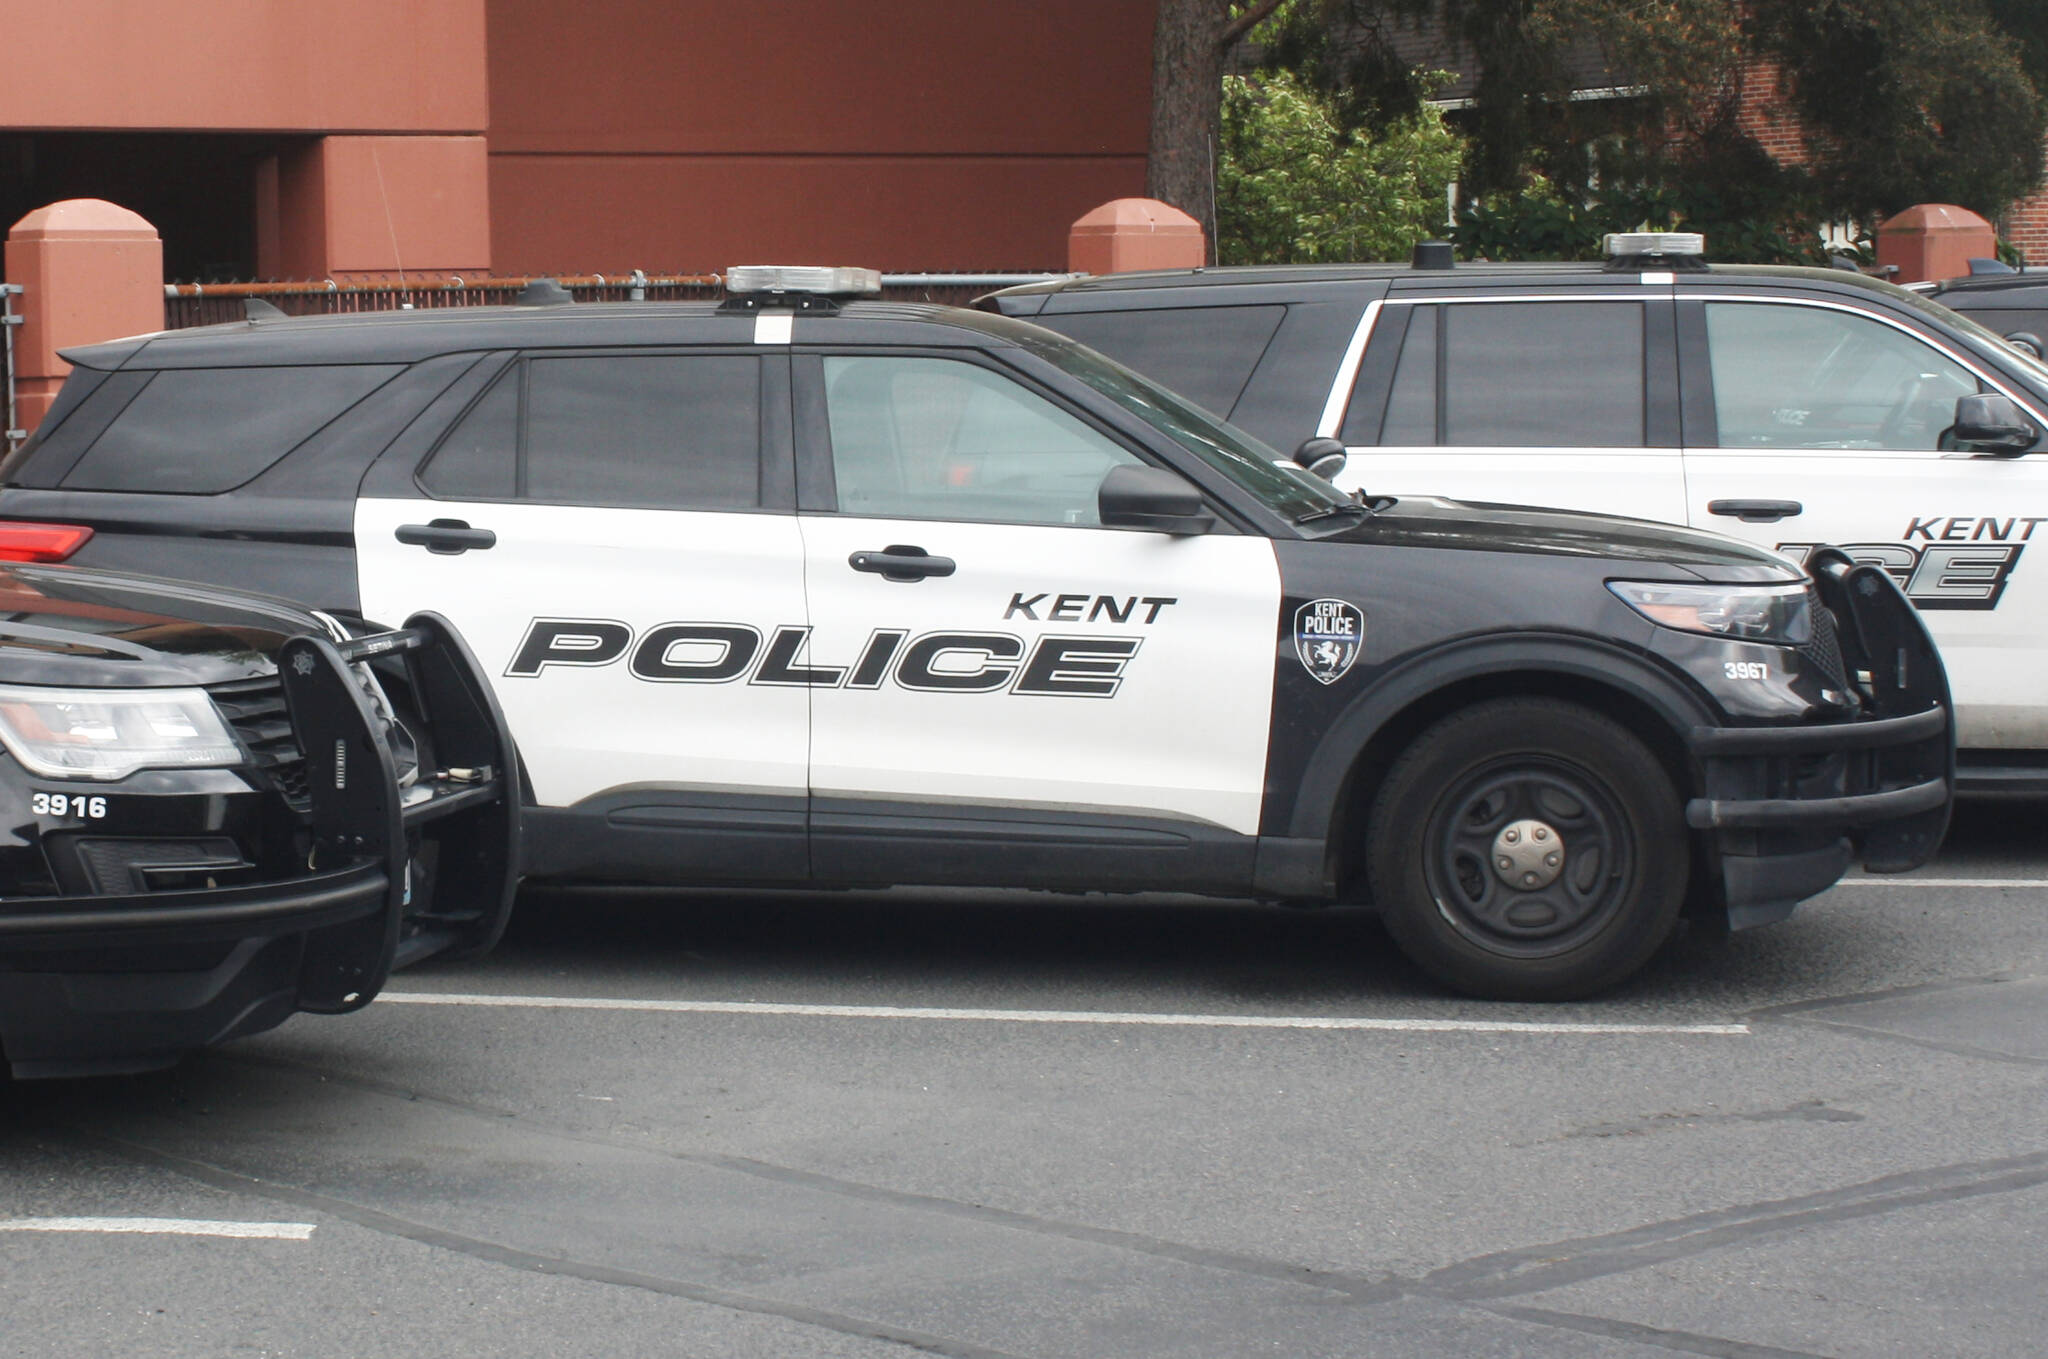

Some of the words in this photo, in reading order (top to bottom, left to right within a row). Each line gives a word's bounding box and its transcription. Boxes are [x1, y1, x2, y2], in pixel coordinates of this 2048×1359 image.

[1904, 517, 2048, 541] KENT
[1002, 592, 1178, 624] KENT
[1314, 602, 1345, 617] KENT
[1304, 615, 1354, 635] POLICE
[502, 616, 1145, 699] POLICE
[1724, 662, 1768, 680] 3967
[32, 793, 107, 818] 3916
